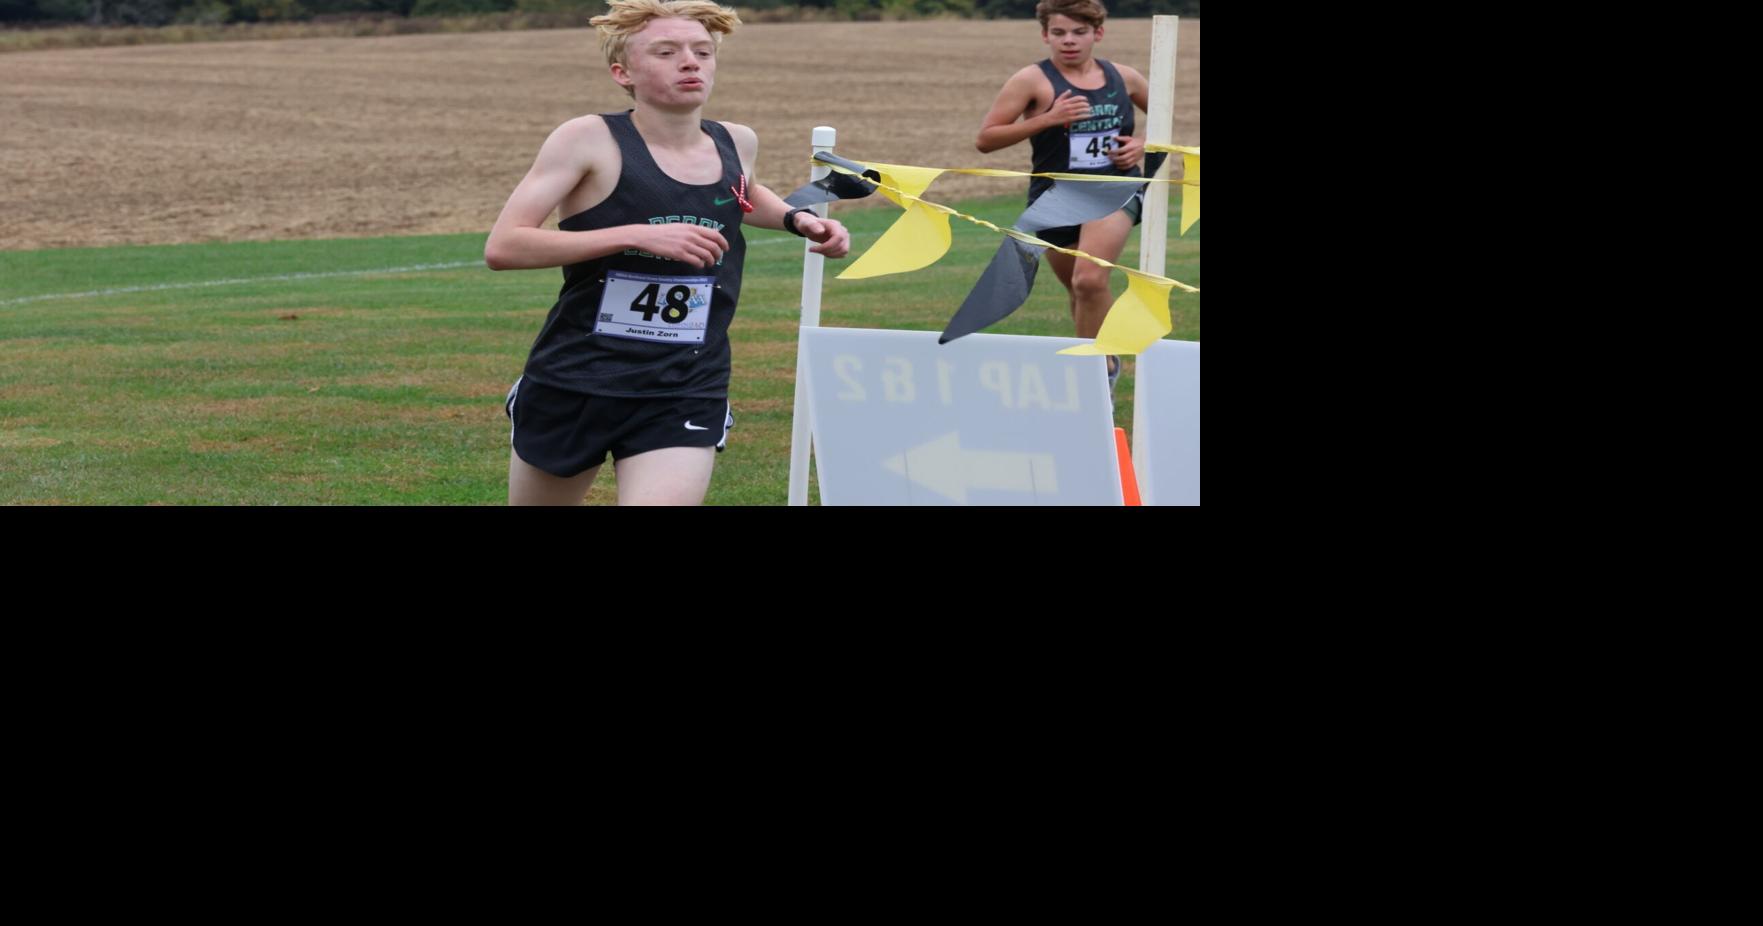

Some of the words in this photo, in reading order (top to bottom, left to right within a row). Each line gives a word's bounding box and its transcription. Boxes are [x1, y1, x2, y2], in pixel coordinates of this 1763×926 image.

[1086, 136, 1112, 158] 45
[630, 283, 691, 324] 48
[625, 327, 655, 336] Justin
[657, 330, 679, 338] Zorn
